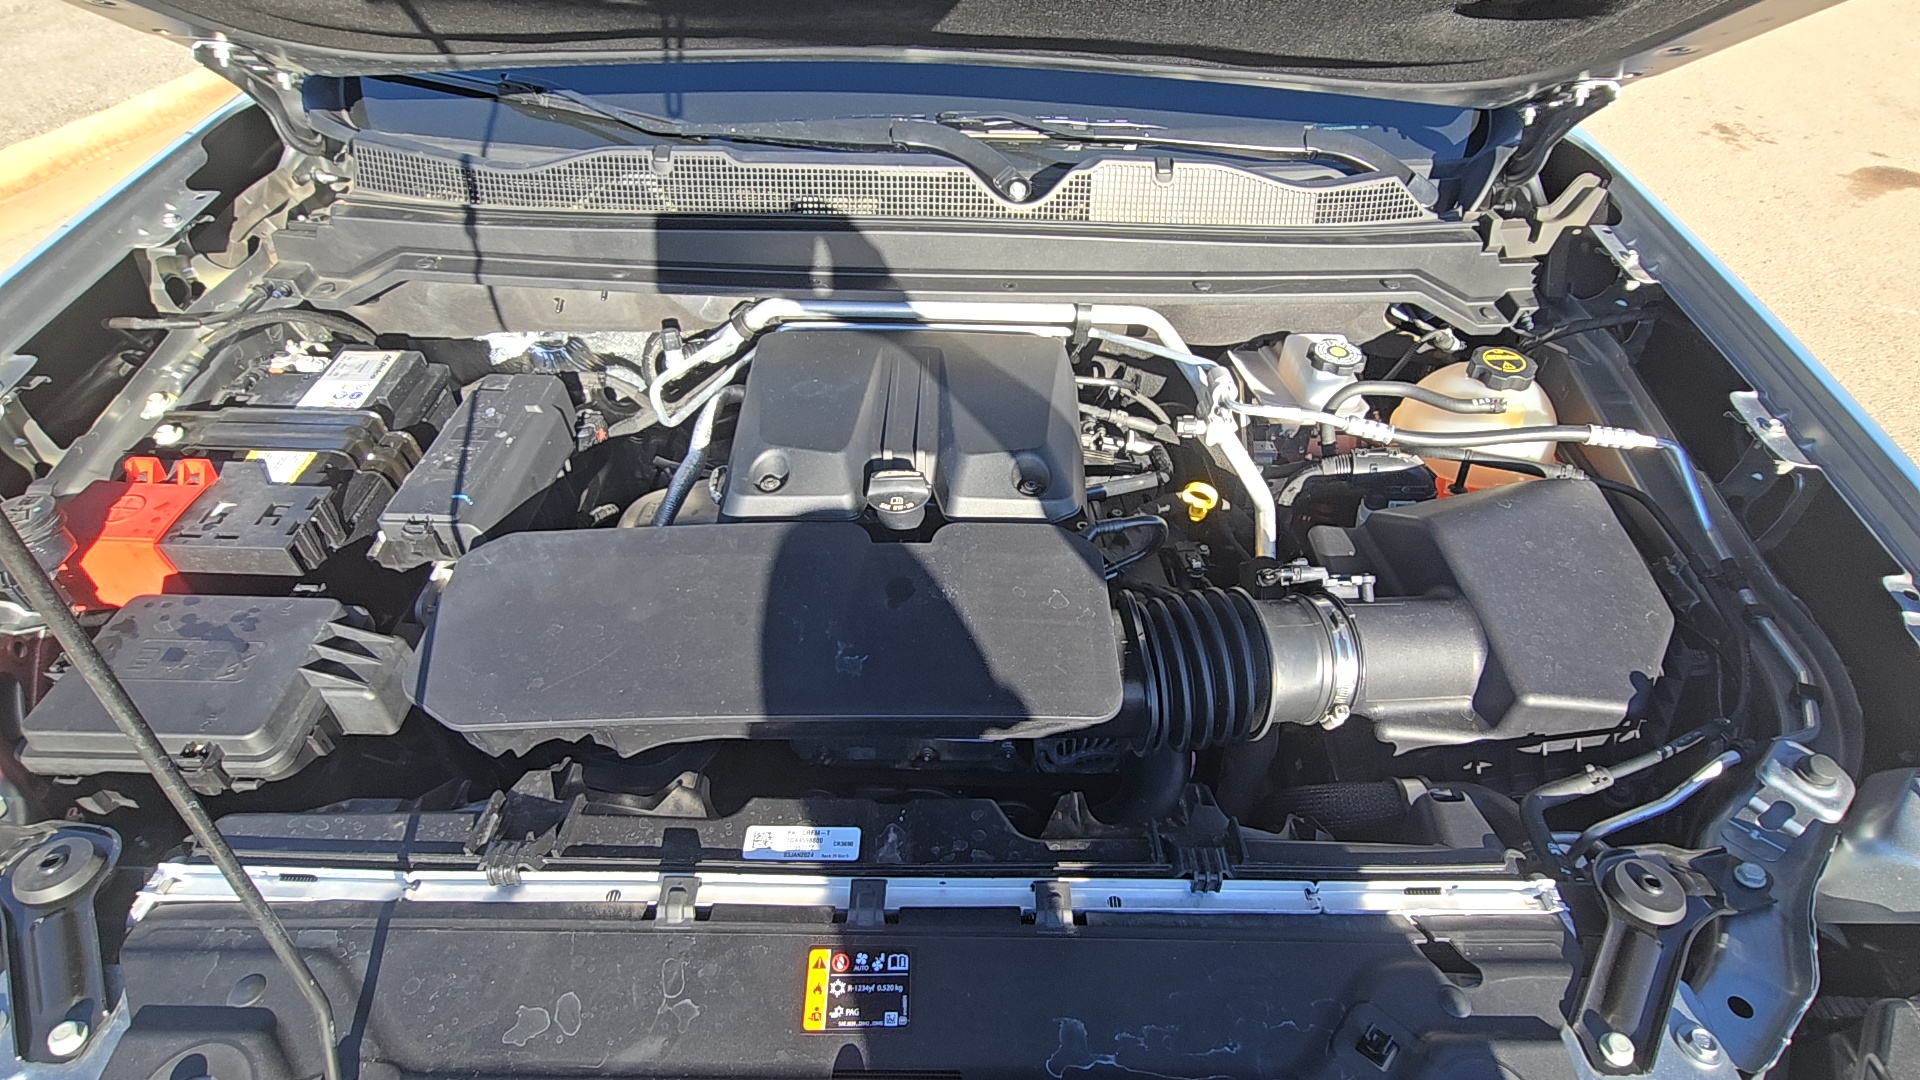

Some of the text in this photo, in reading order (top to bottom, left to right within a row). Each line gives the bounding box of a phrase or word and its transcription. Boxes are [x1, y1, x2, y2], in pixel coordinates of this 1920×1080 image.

[853, 964, 870, 972] AUTO
[847, 983, 904, 993] R-1234yf 0.520 kg
[845, 1007, 860, 1017] PAG
